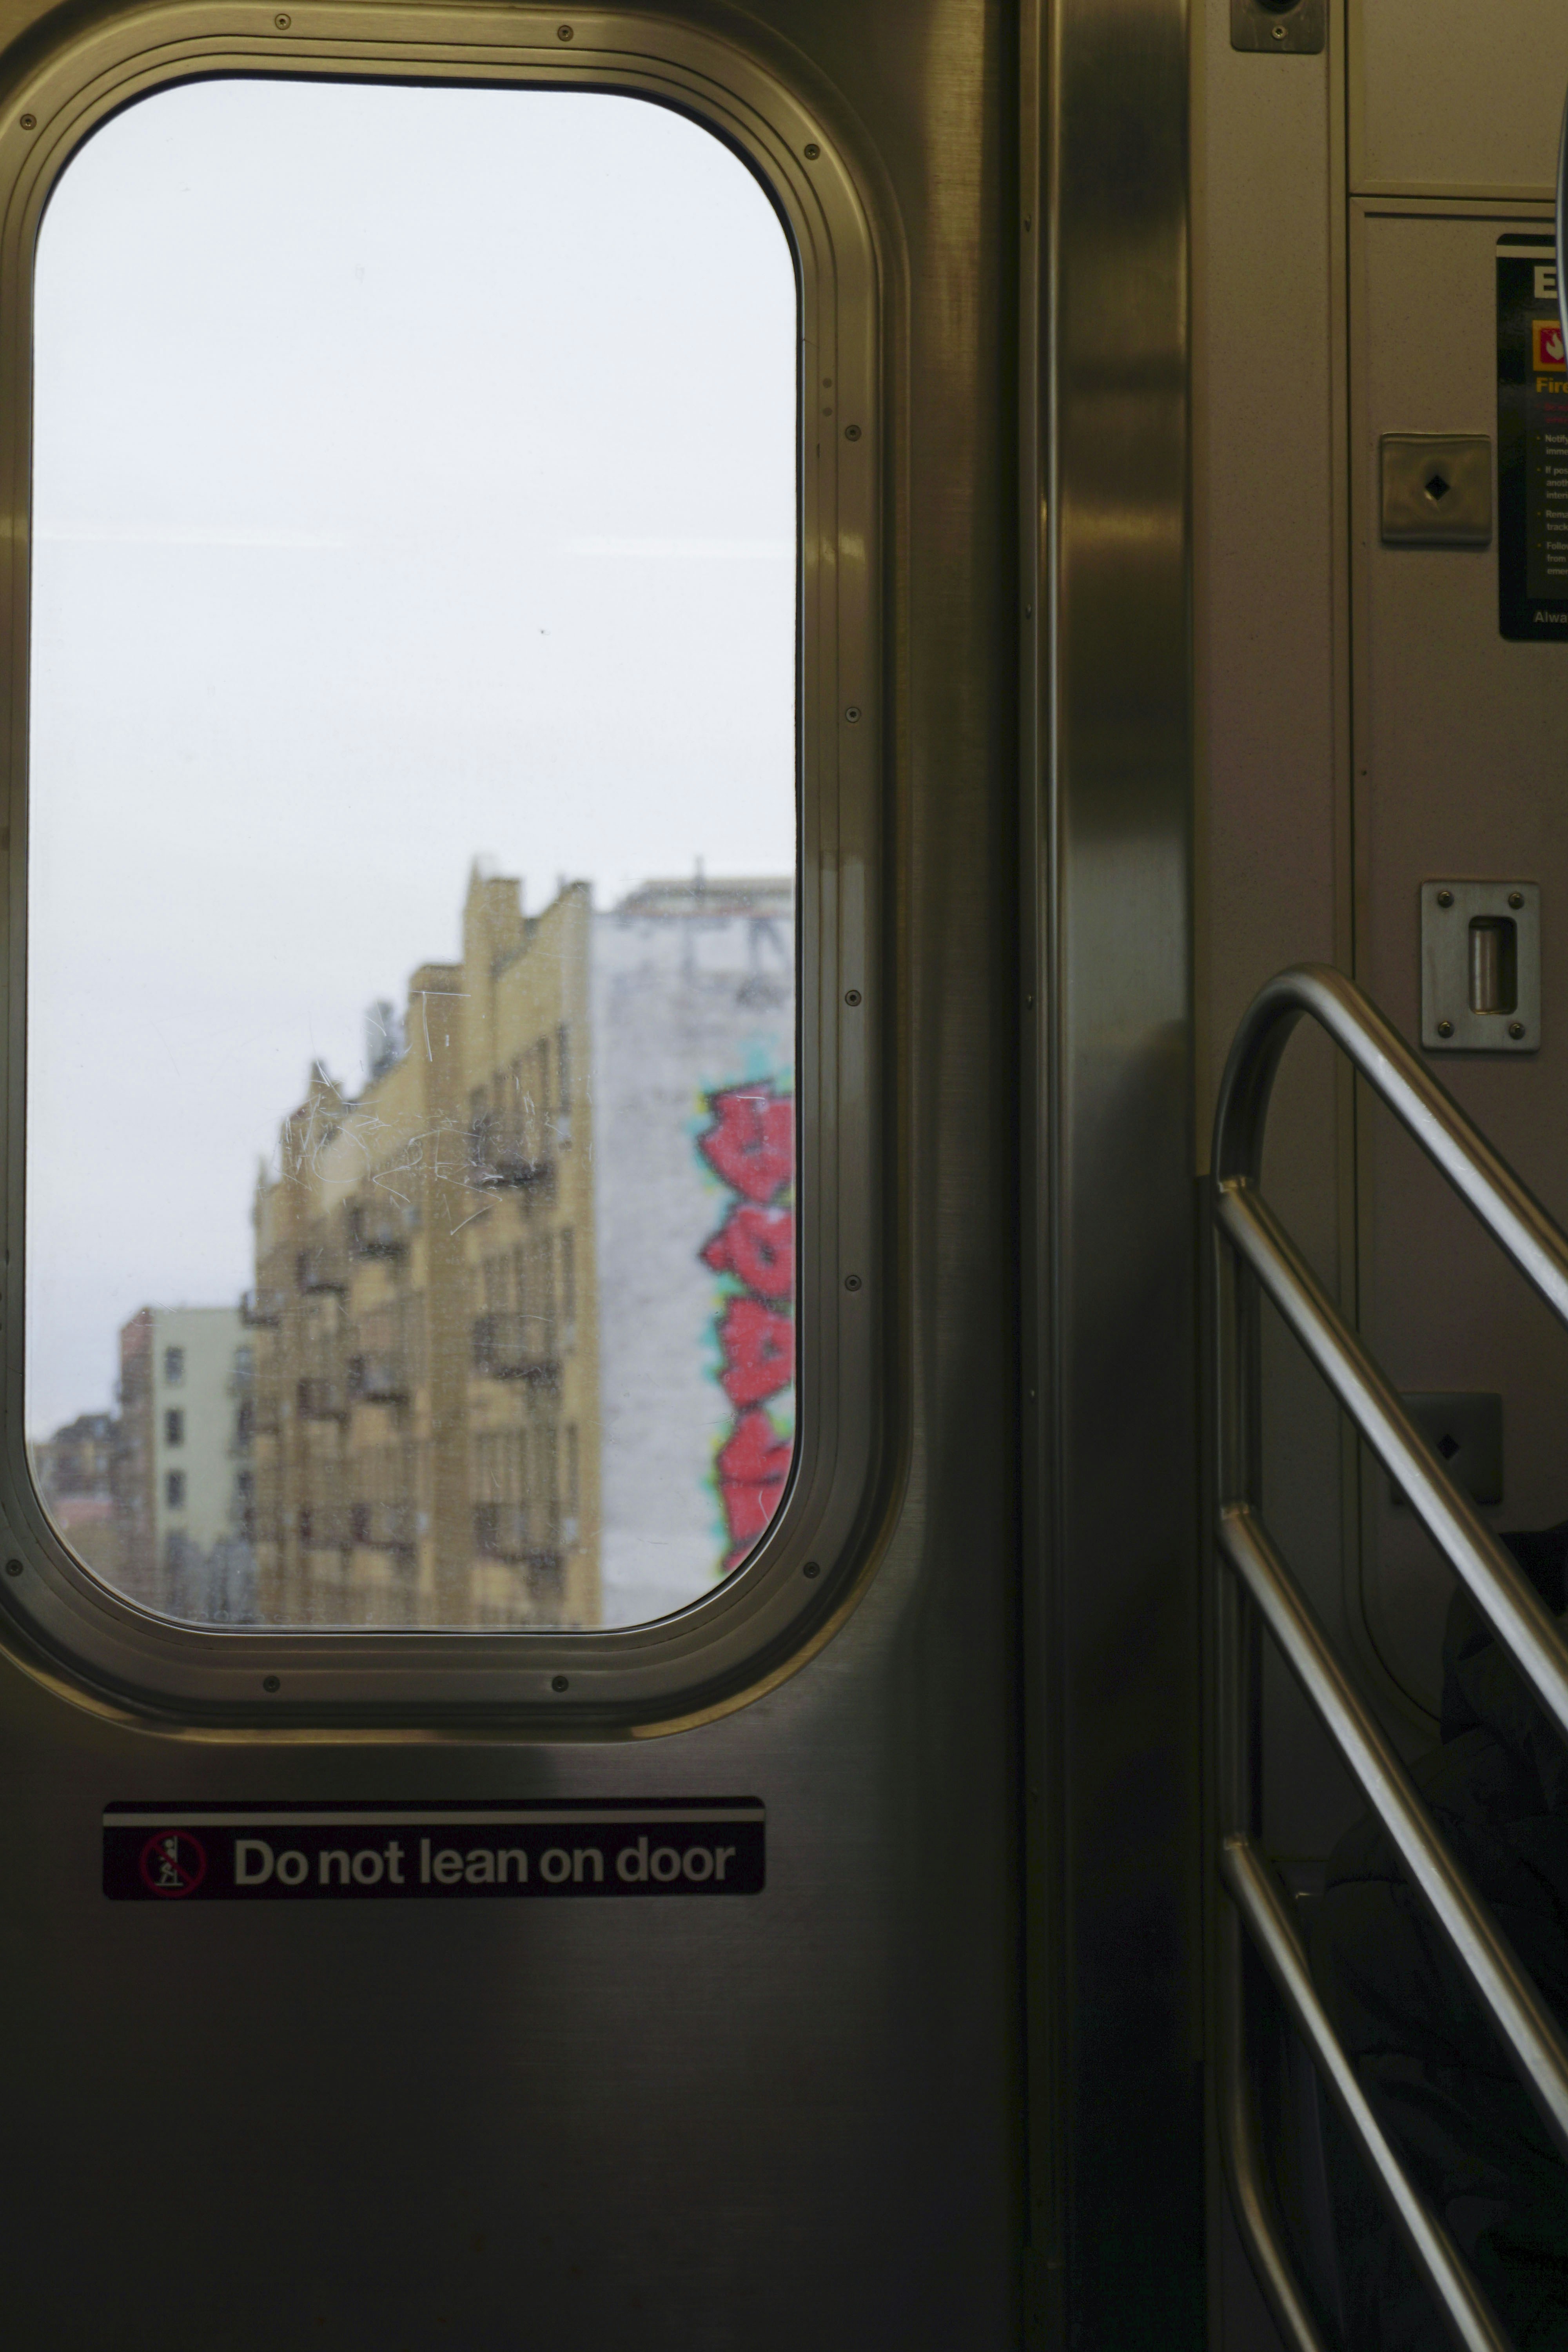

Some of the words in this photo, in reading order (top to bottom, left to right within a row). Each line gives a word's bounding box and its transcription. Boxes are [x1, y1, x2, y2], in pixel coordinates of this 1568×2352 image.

[1546, 554, 1566, 563] from
[235, 1839, 309, 1886] Do
[319, 1841, 405, 1885] not
[420, 1838, 528, 1884] lean
[539, 1848, 604, 1883] on
[615, 1837, 736, 1882] door
